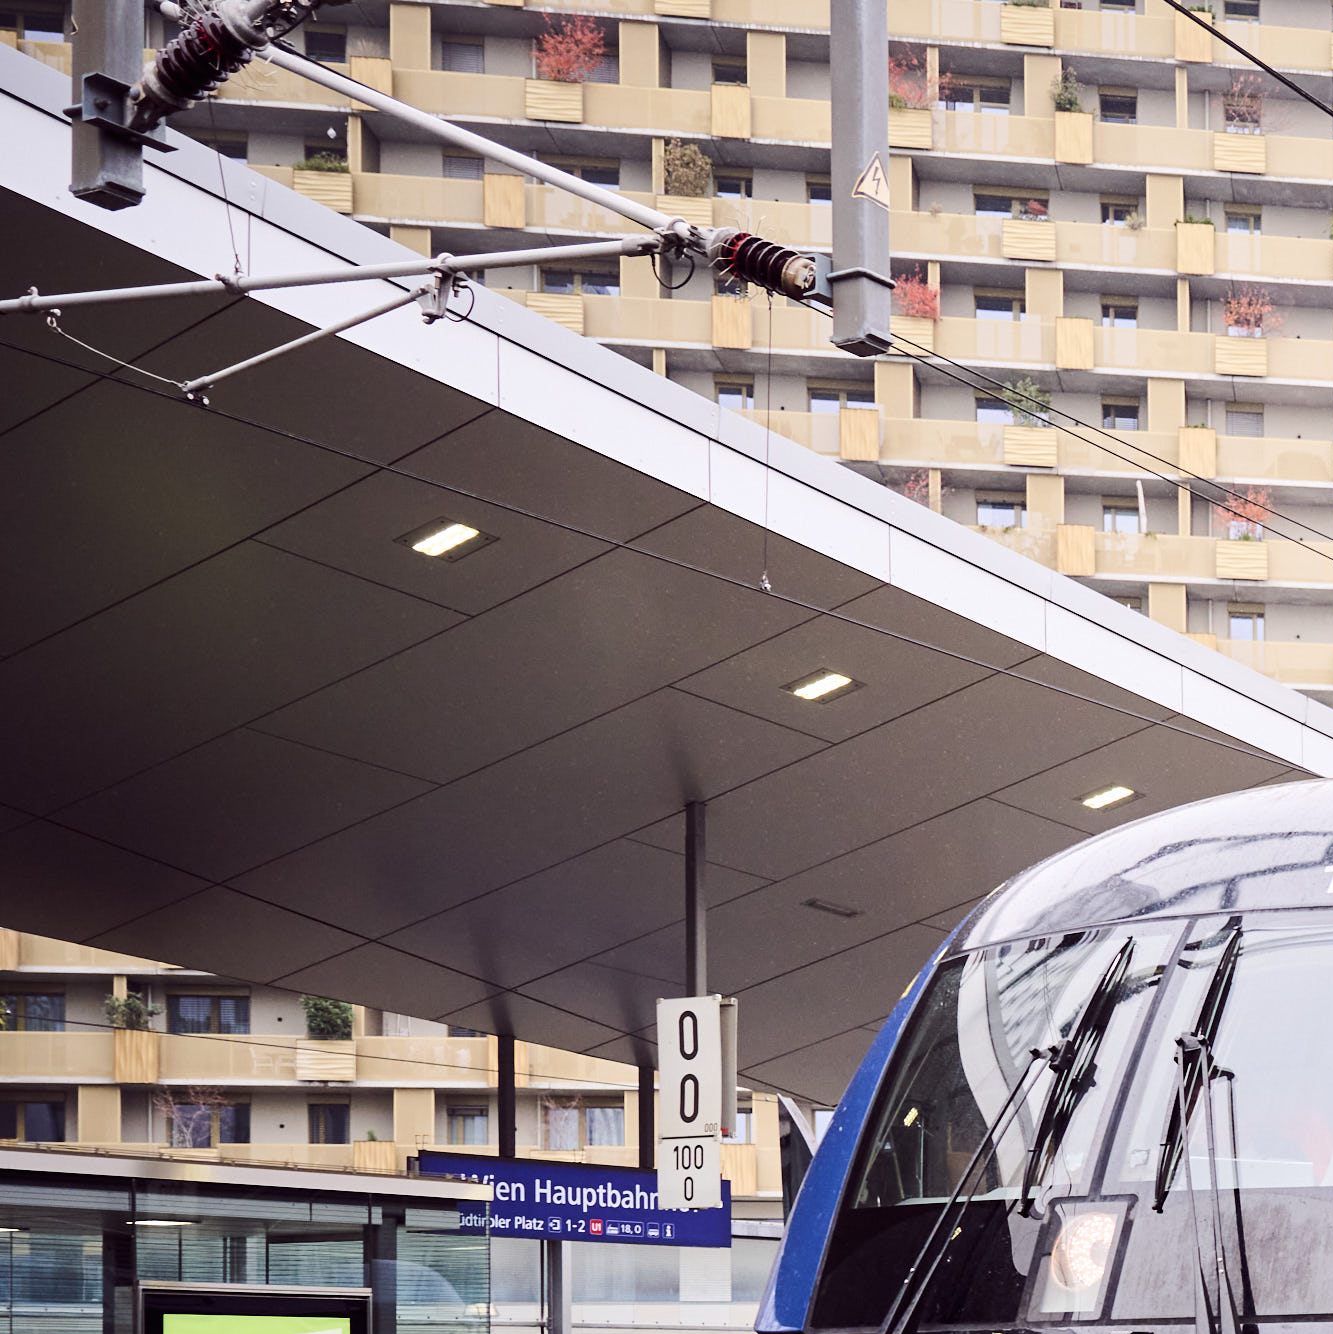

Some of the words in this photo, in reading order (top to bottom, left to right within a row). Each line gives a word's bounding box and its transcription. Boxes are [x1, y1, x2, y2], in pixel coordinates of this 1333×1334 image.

[678, 1010, 698, 1061] 0
[679, 1073, 699, 1124] 0
[673, 1145, 704, 1171] 100
[683, 1176, 695, 1202] 0
[514, 1216, 544, 1231] Platz
[565, 1220, 586, 1233] 1-2
[591, 1222, 602, 1232] U1
